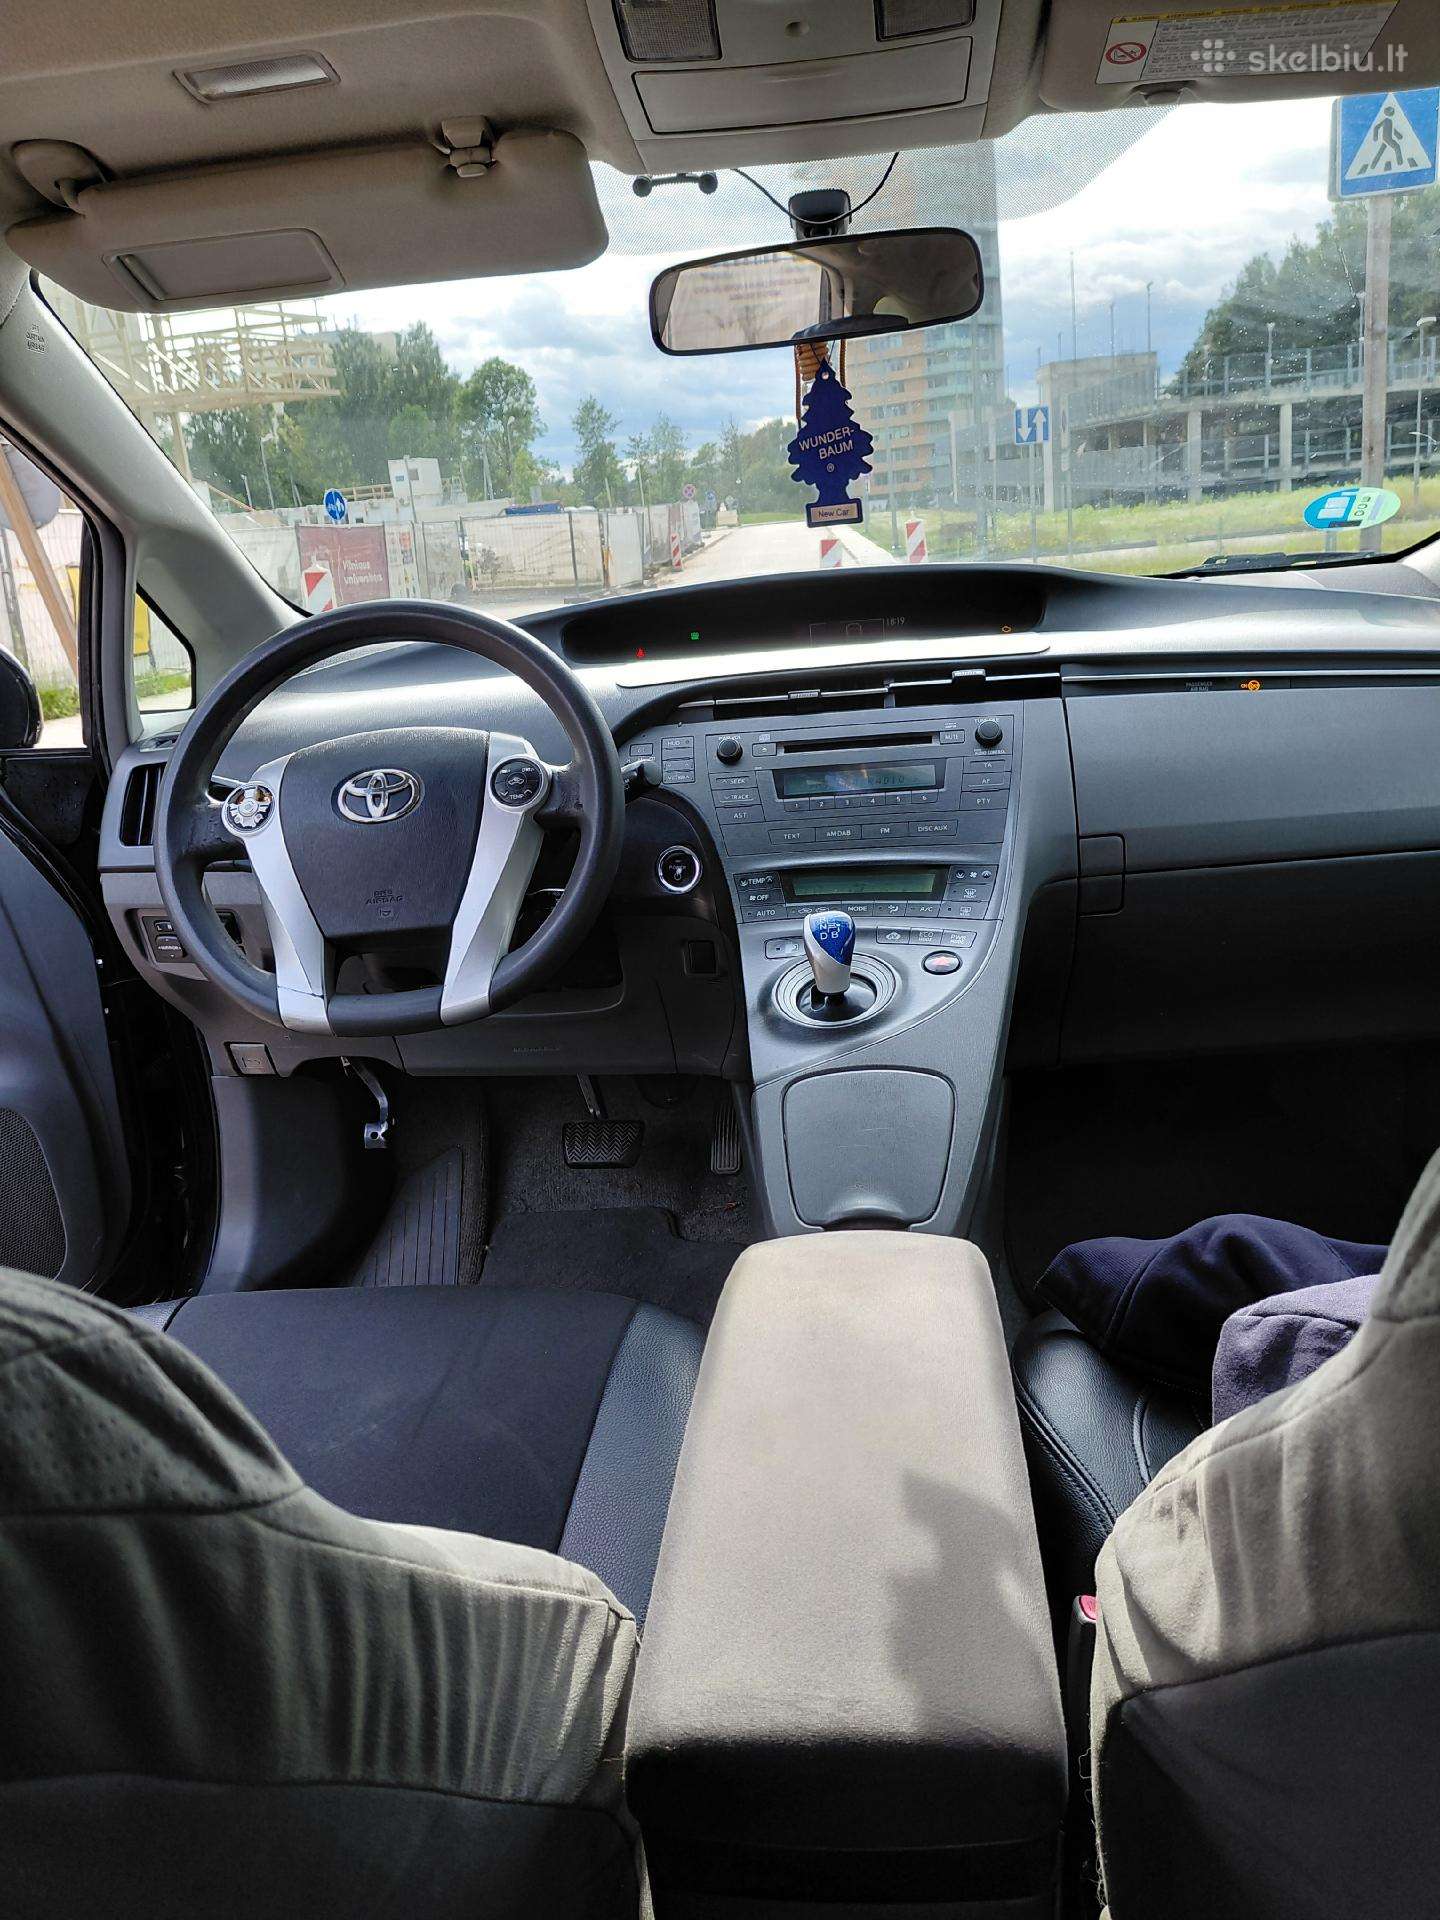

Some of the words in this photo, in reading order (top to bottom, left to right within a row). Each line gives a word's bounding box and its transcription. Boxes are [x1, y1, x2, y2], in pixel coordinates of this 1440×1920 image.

[799, 426, 855, 452] WUNDER-
[819, 440, 854, 460] BAUM
[818, 509, 834, 519] New
[836, 507, 850, 517] Car
[880, 827, 890, 835] FM
[756, 909, 776, 917] AUTO
[820, 932, 828, 940] D
[831, 931, 839, 939] B
